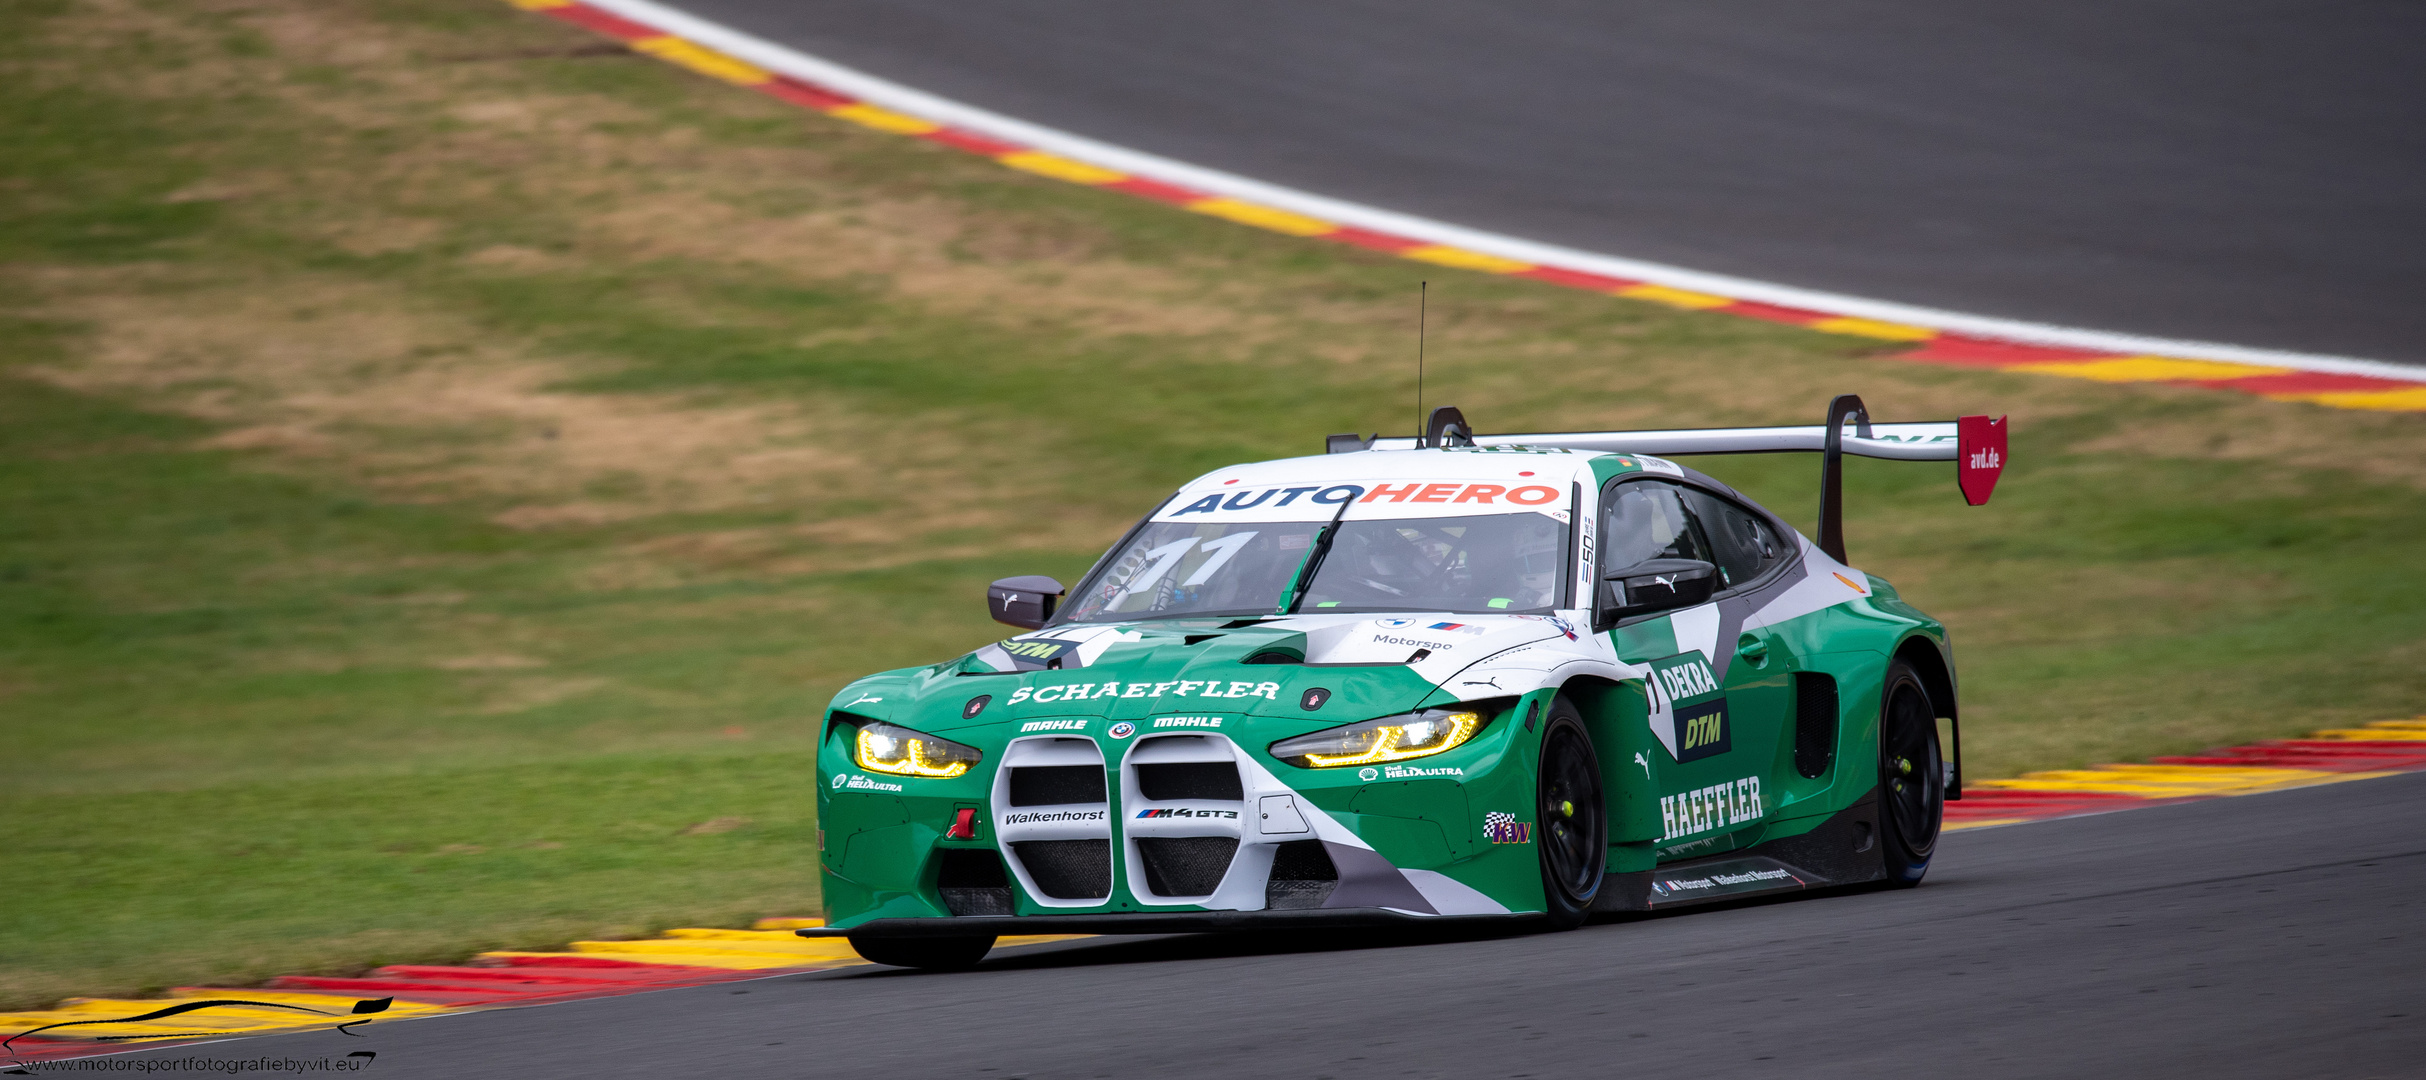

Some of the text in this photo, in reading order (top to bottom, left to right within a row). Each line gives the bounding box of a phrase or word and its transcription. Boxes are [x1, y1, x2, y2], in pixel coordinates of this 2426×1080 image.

[1970, 447, 2000, 470] avd.de
[1169, 483, 1560, 517] AUTOHERO
[1127, 531, 1260, 595] 11
[1000, 639, 1063, 659] DTM
[1660, 659, 1718, 701] DEKRA
[1007, 680, 1280, 705] SCHAEFFLER
[1020, 720, 1088, 732] MAHLE
[1153, 717, 1223, 728] MAHLE
[1684, 711, 1722, 750] DTM
[1384, 767, 1464, 778] HELIX ULTRA
[873, 782, 903, 792] ULTRA
[1005, 810, 1105, 825] Walkenhorst
[1153, 808, 1239, 819] M4 GT3
[1654, 776, 1764, 843] HAEFFLER
[1492, 822, 1532, 844] KW
